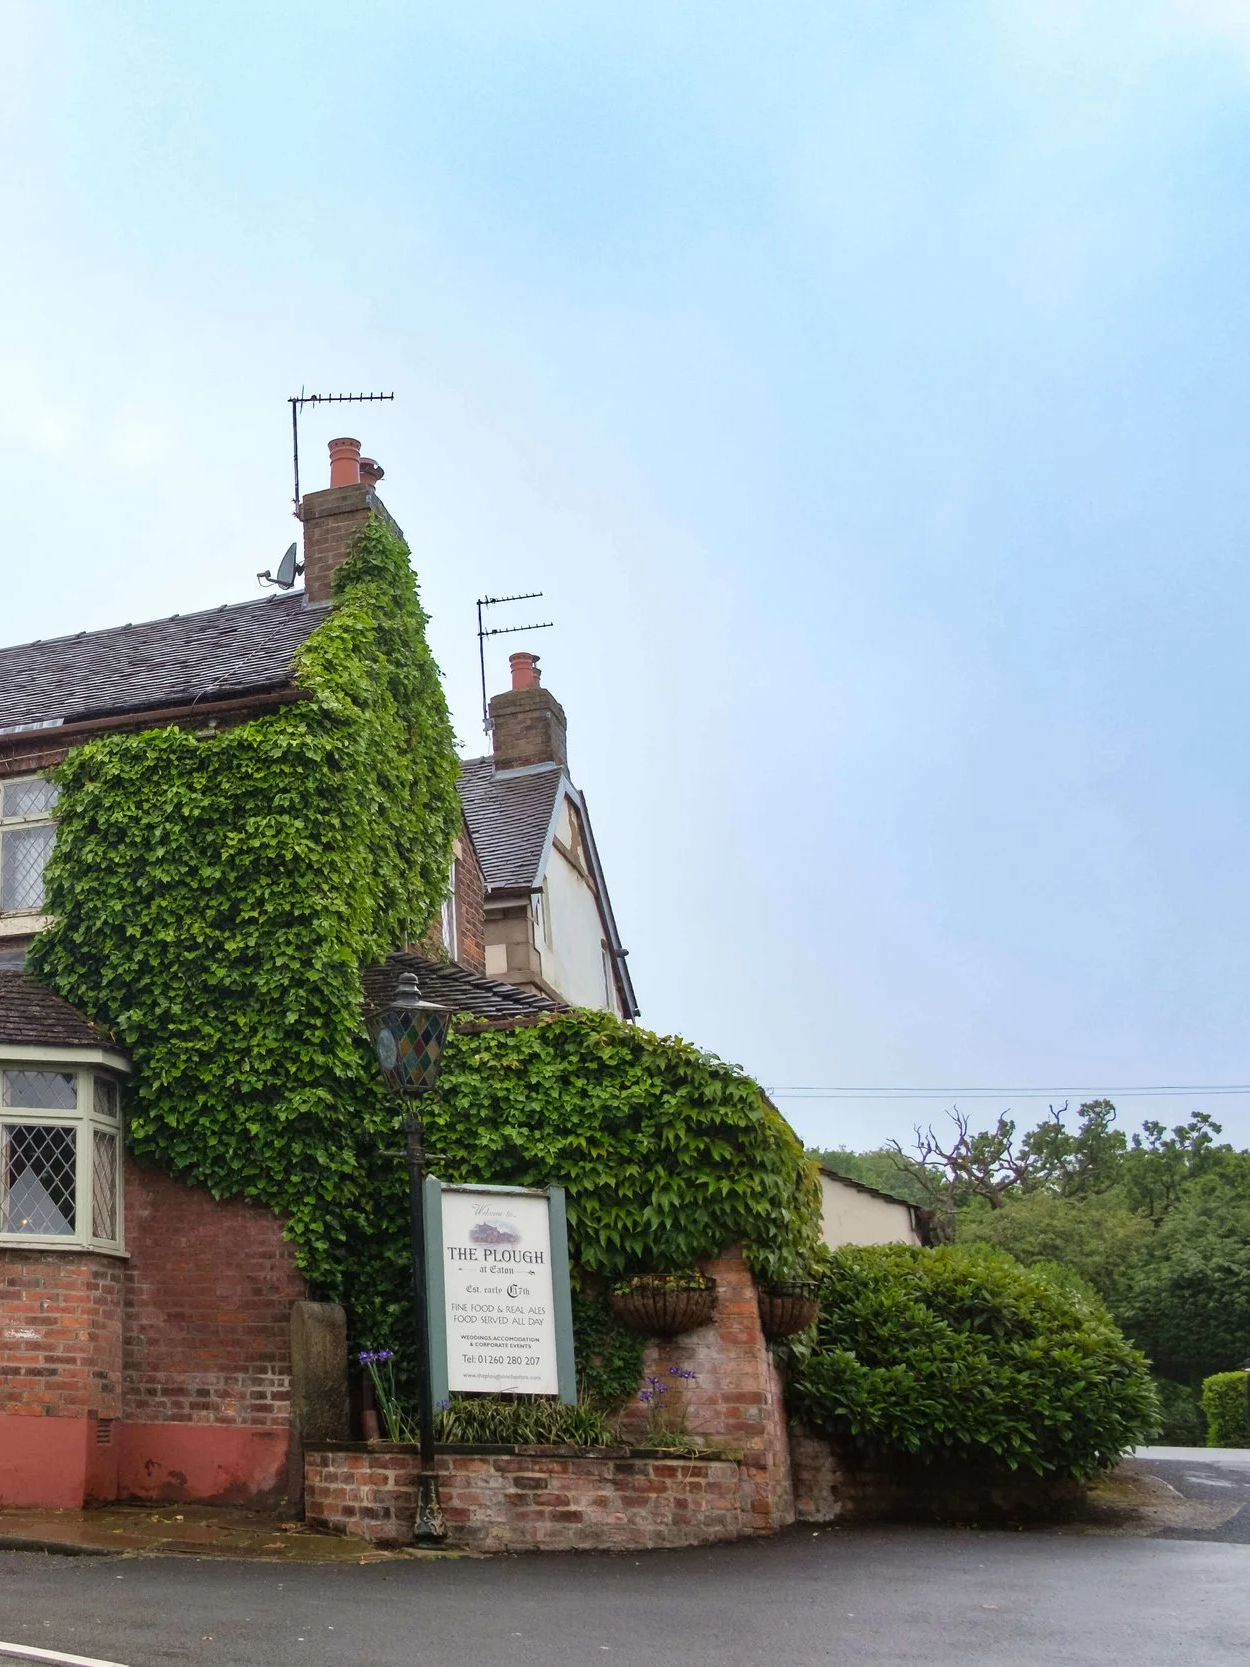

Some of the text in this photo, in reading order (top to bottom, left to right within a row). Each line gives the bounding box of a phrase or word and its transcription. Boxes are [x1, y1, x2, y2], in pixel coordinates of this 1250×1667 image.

[472, 1203, 502, 1216] Welcome
[447, 1246, 544, 1264] THE PLOUGH
[479, 1265, 514, 1275] at Eaton
[465, 1284, 482, 1294] Est.
[483, 1286, 503, 1296] early
[451, 1302, 546, 1315] FINE FOOD & REAL ALES
[453, 1314, 545, 1326] FOOD SERVED ALL DAY
[475, 1341, 509, 1349] CORPORATE
[462, 1354, 541, 1366] Tel: 01260 280 207
